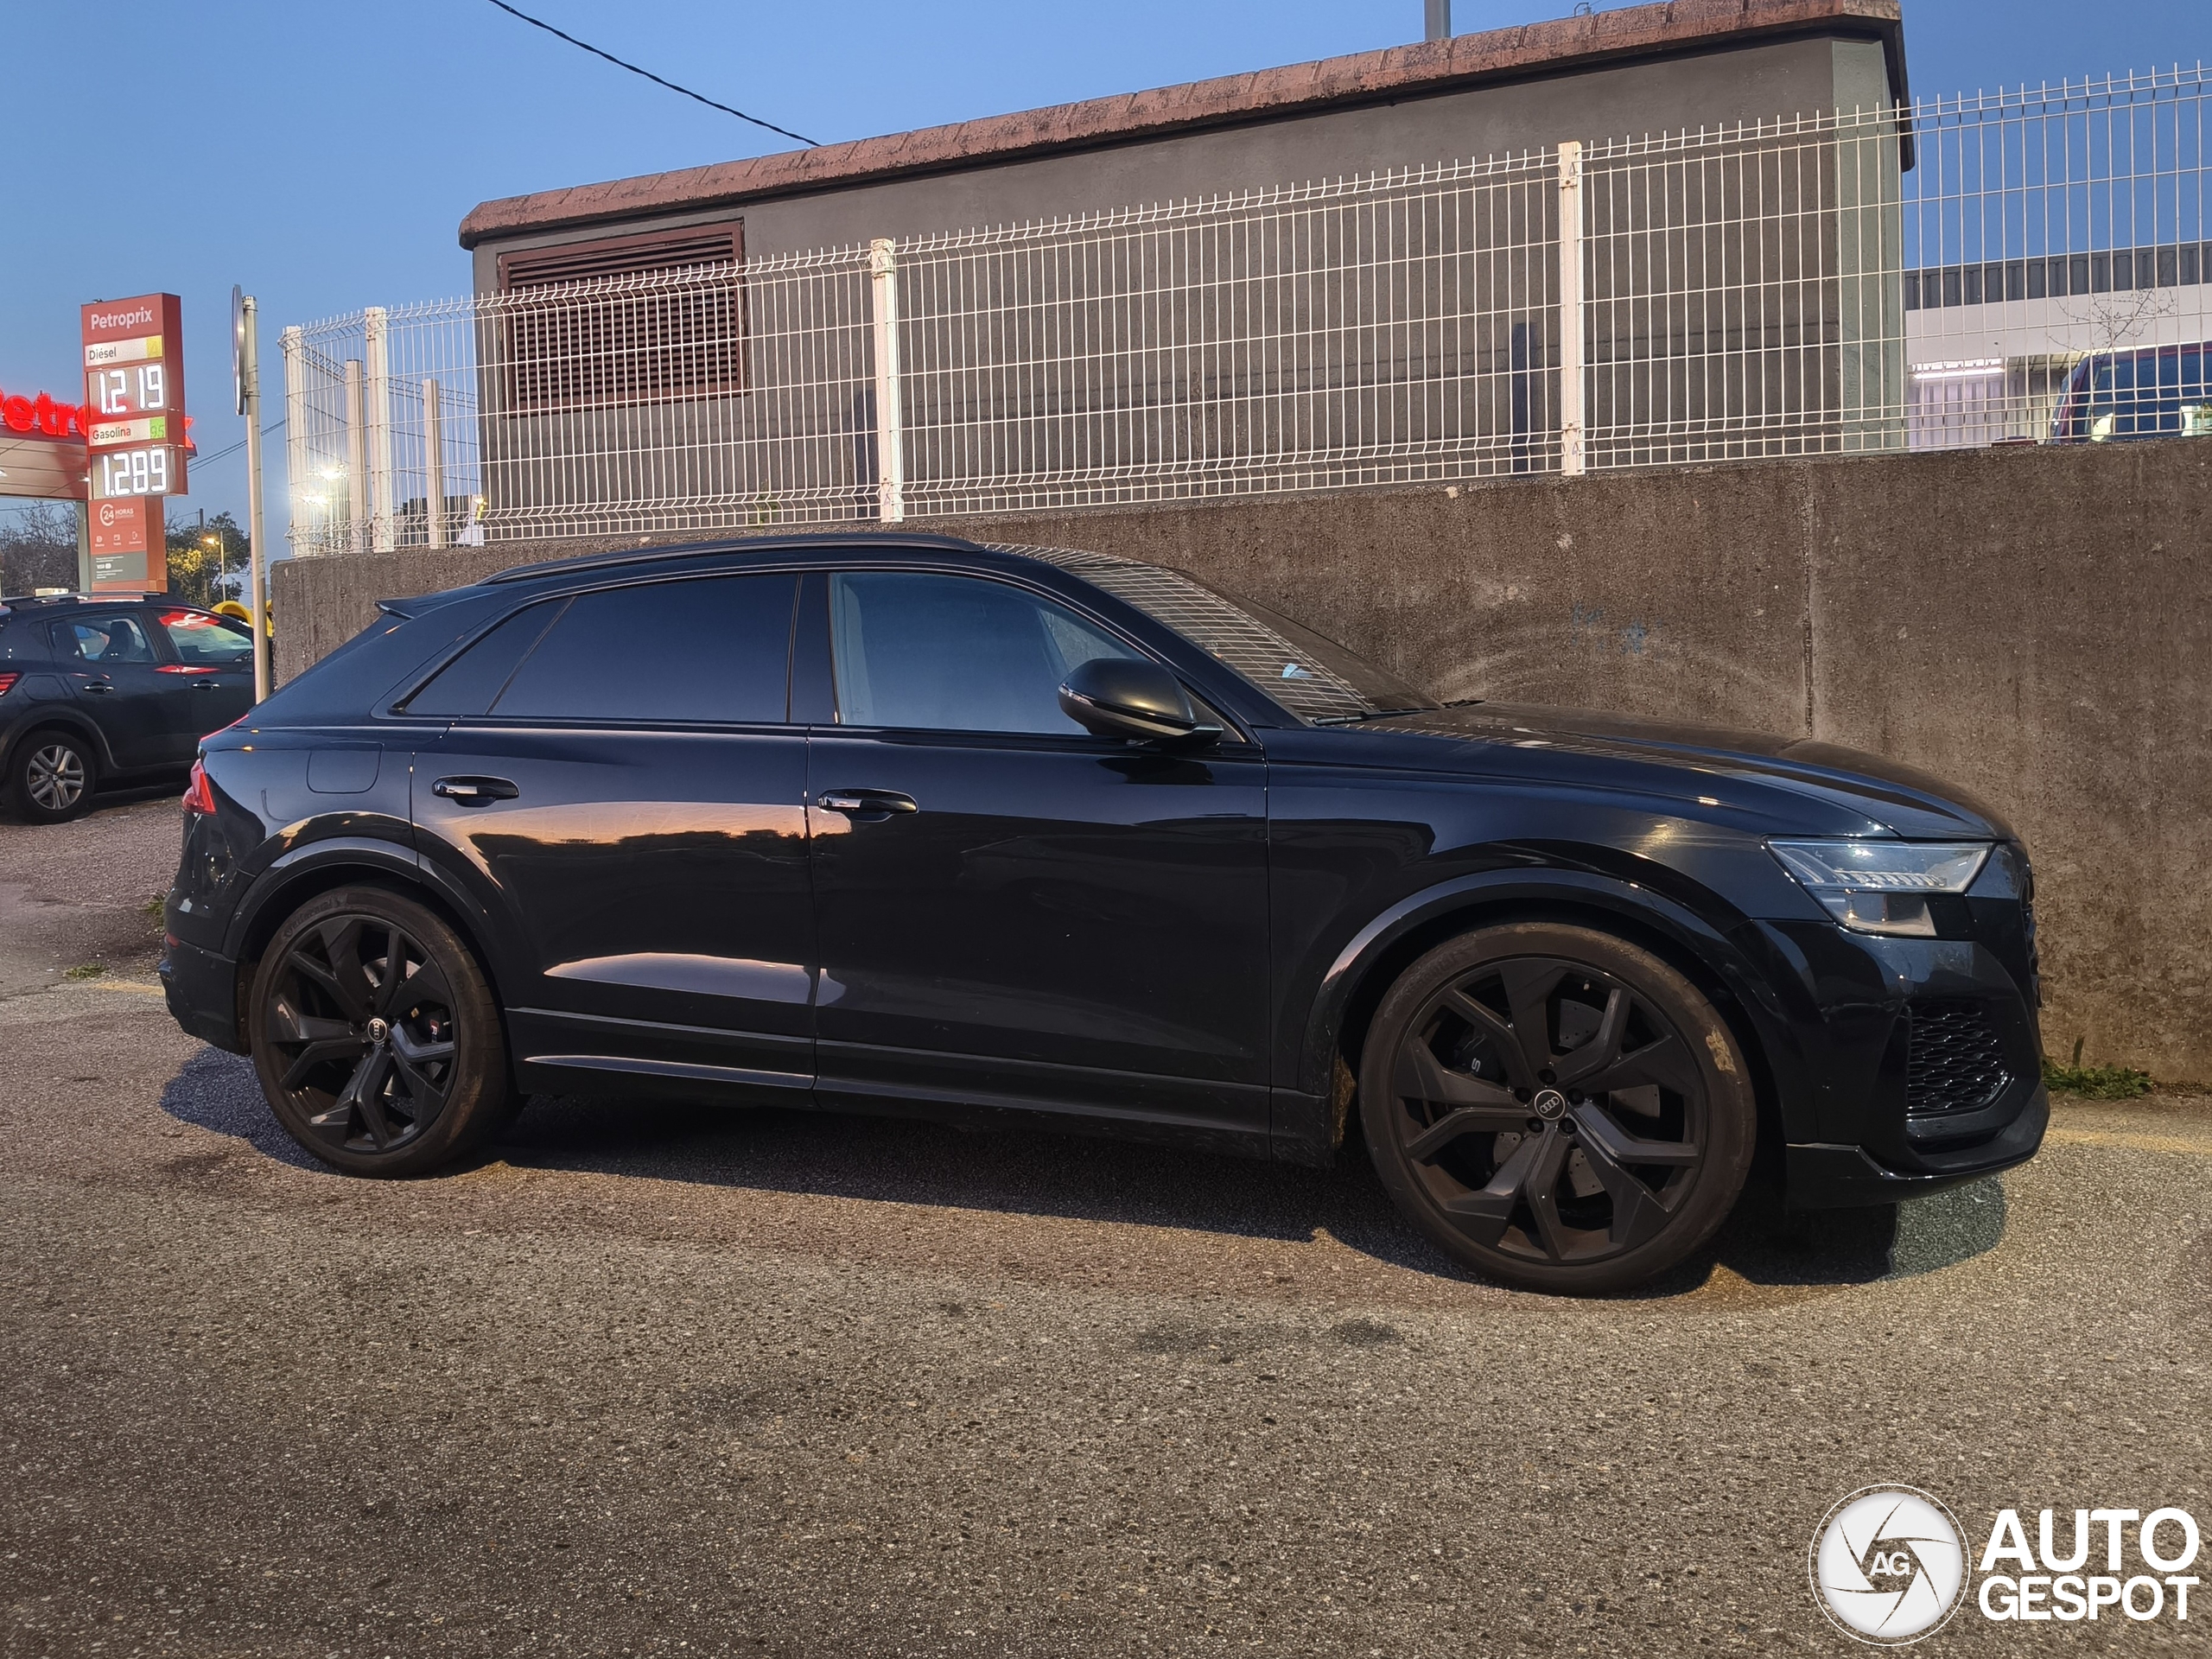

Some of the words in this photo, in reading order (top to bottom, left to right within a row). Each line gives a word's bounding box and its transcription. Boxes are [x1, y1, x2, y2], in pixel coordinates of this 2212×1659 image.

[91, 306, 153, 330] Petroprix
[89, 346, 117, 360] Diésel
[92, 427, 131, 440] Gasolina
[104, 449, 167, 497] 1.289
[103, 510, 114, 520] 24
